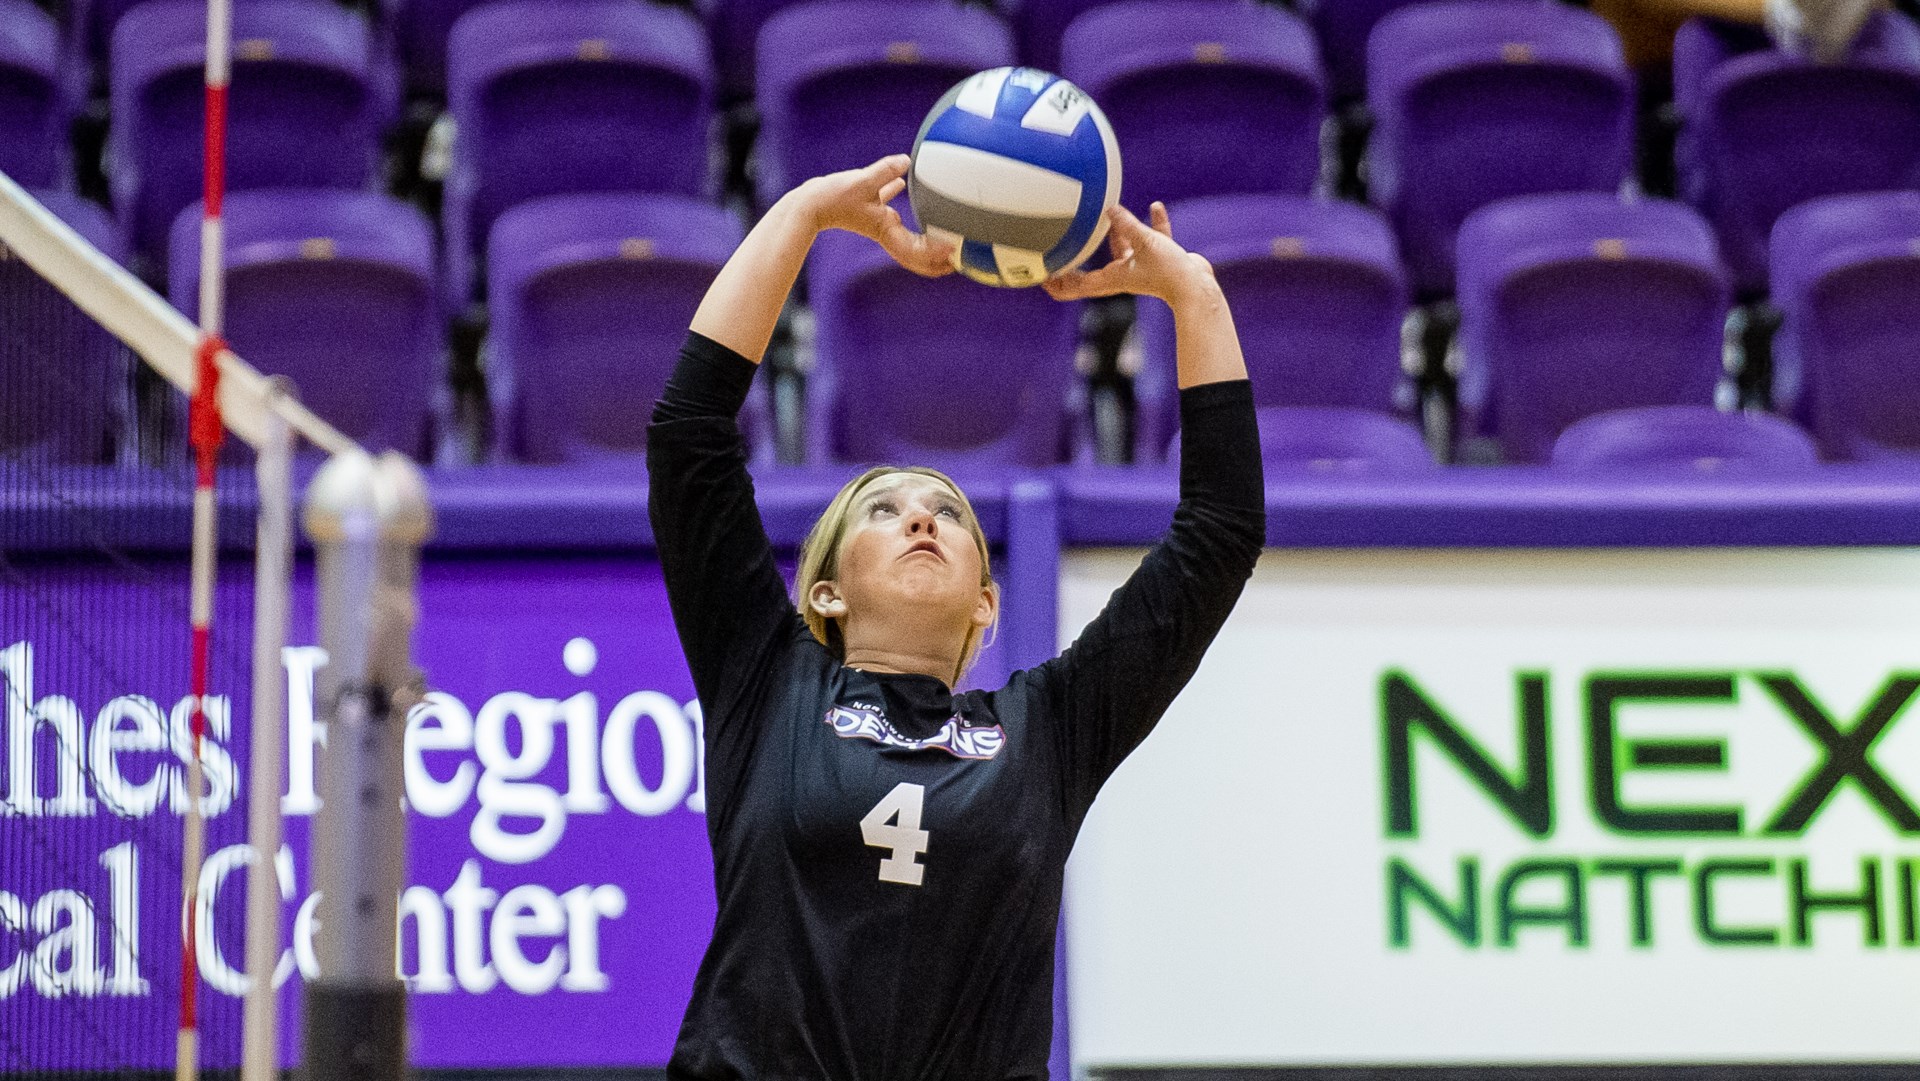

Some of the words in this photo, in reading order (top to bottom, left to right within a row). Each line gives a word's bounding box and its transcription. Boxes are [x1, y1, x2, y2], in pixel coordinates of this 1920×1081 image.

[280, 638, 704, 862] egio
[859, 782, 929, 885] 4
[1382, 667, 1920, 838] NEX
